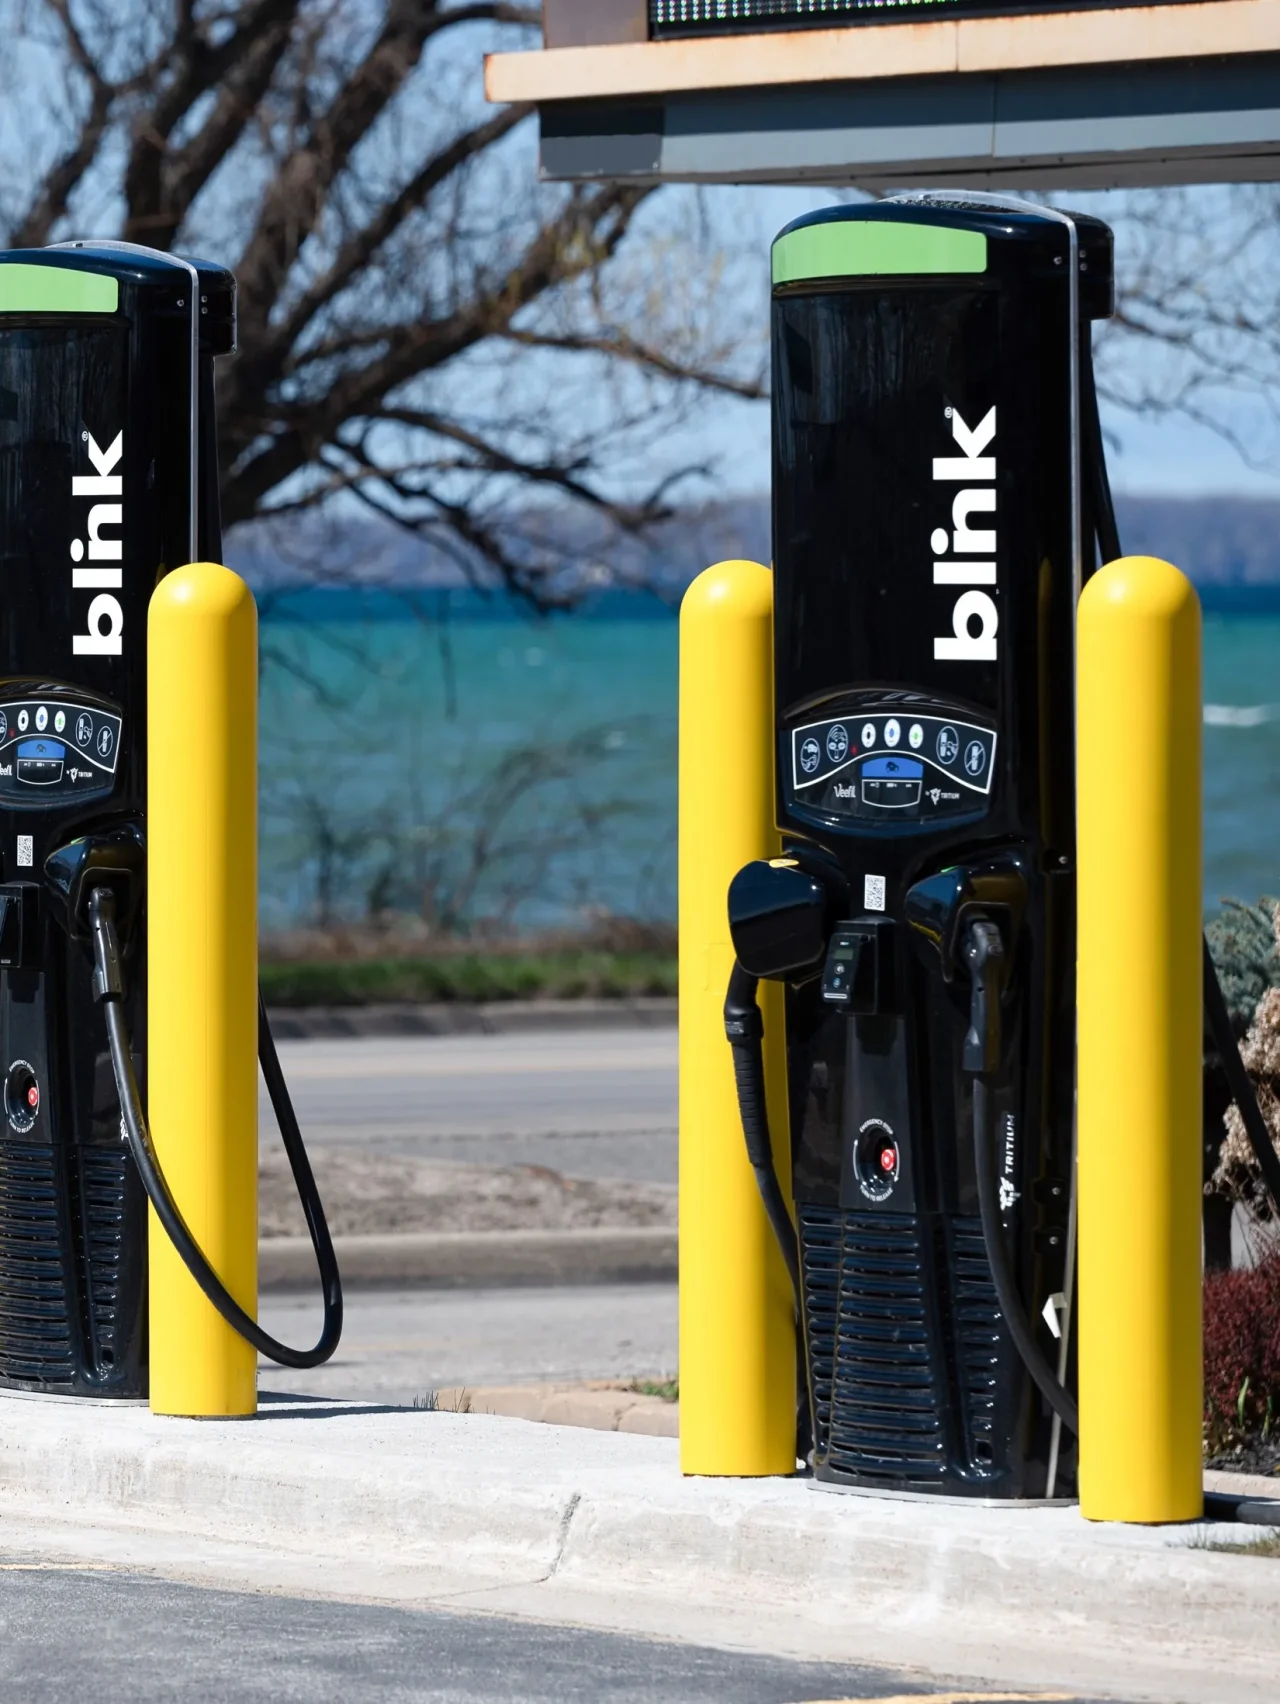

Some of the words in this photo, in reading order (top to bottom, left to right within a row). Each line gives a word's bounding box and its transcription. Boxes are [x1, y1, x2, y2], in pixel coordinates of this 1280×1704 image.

[70, 429, 124, 656] blink
[930, 405, 999, 661] blink
[1004, 1114, 1015, 1175] TRITIUM
